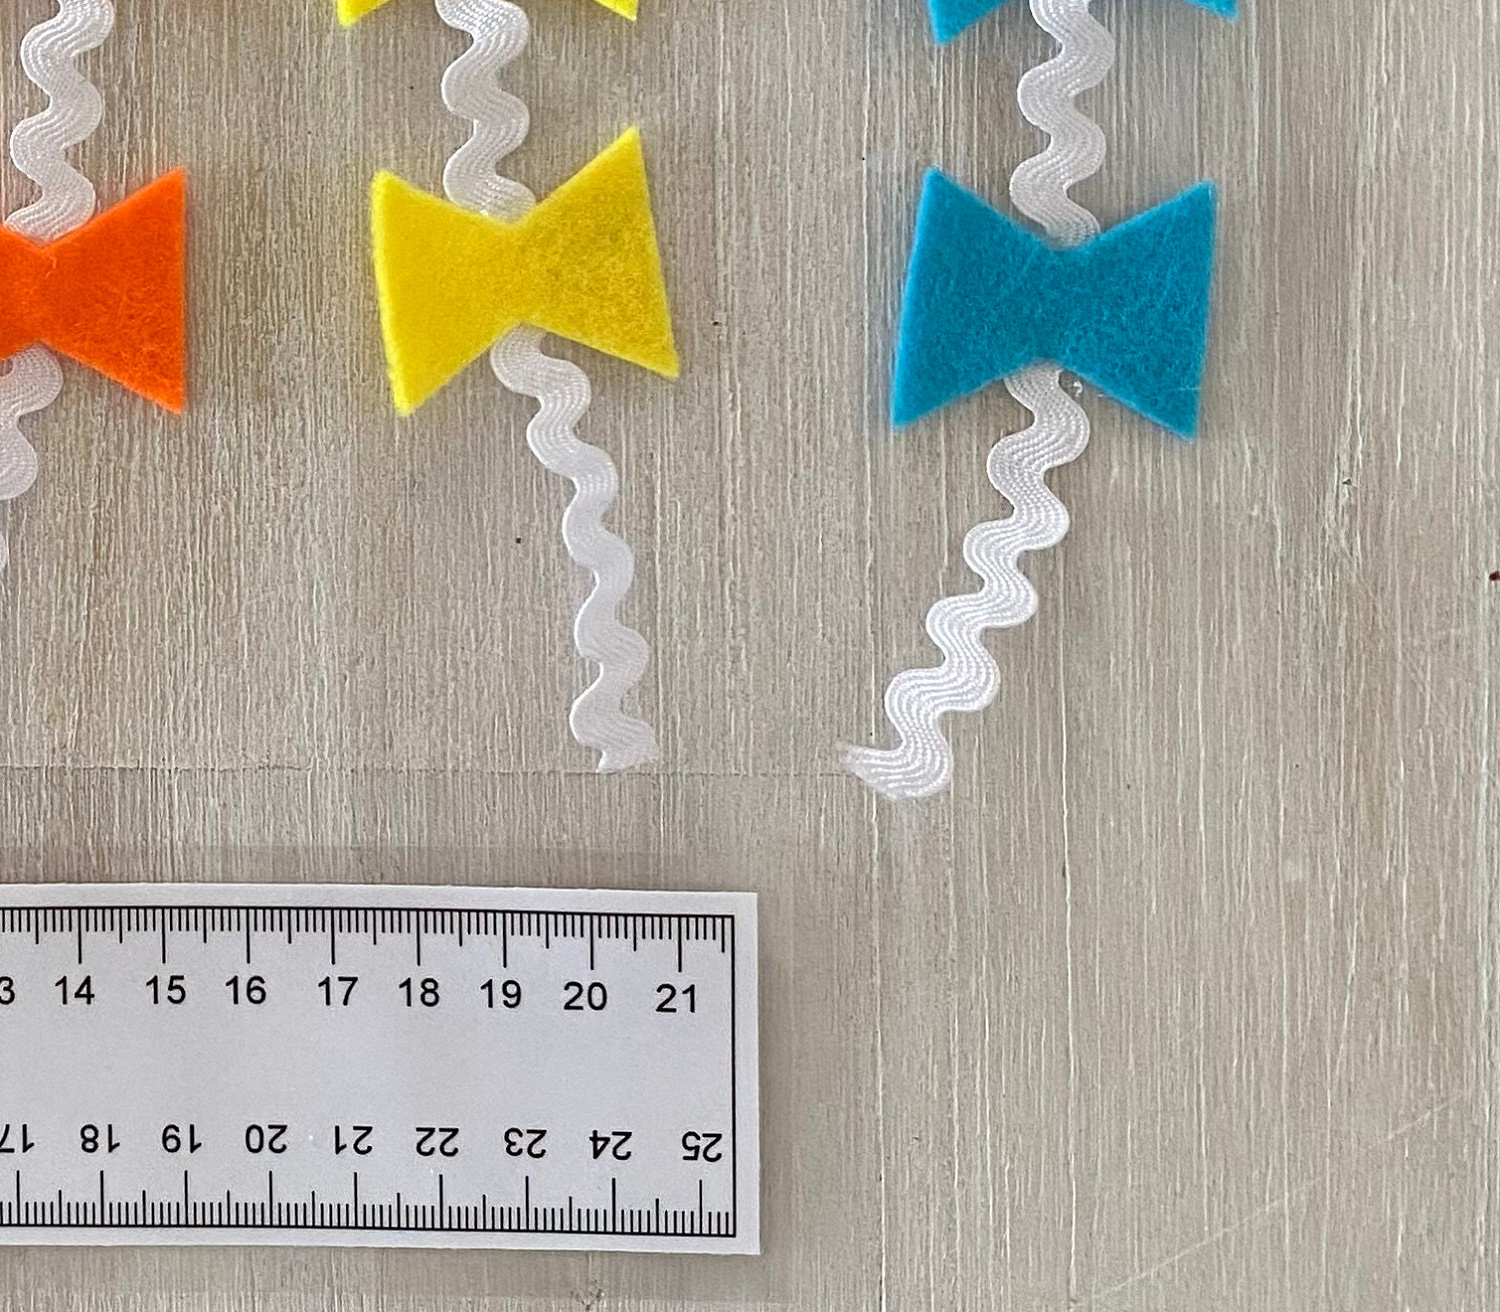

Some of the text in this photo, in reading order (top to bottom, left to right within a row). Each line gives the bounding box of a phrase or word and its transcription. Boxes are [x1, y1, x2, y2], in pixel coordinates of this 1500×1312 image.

[54, 974, 96, 1006] 14
[145, 974, 187, 1005] 15
[225, 974, 267, 1005] 16
[317, 975, 359, 1007] 17
[398, 977, 440, 1008] 18
[480, 978, 522, 1009] 19
[563, 980, 608, 1011] 20
[655, 983, 696, 1014] 21
[79, 1123, 121, 1154] 18
[161, 1123, 203, 1154] 19
[244, 1123, 288, 1154] 20
[334, 1125, 374, 1156] 21
[415, 1126, 460, 1158] 22
[503, 1127, 548, 1159] 23
[588, 1129, 633, 1161] 24
[681, 1130, 723, 1163] 25
